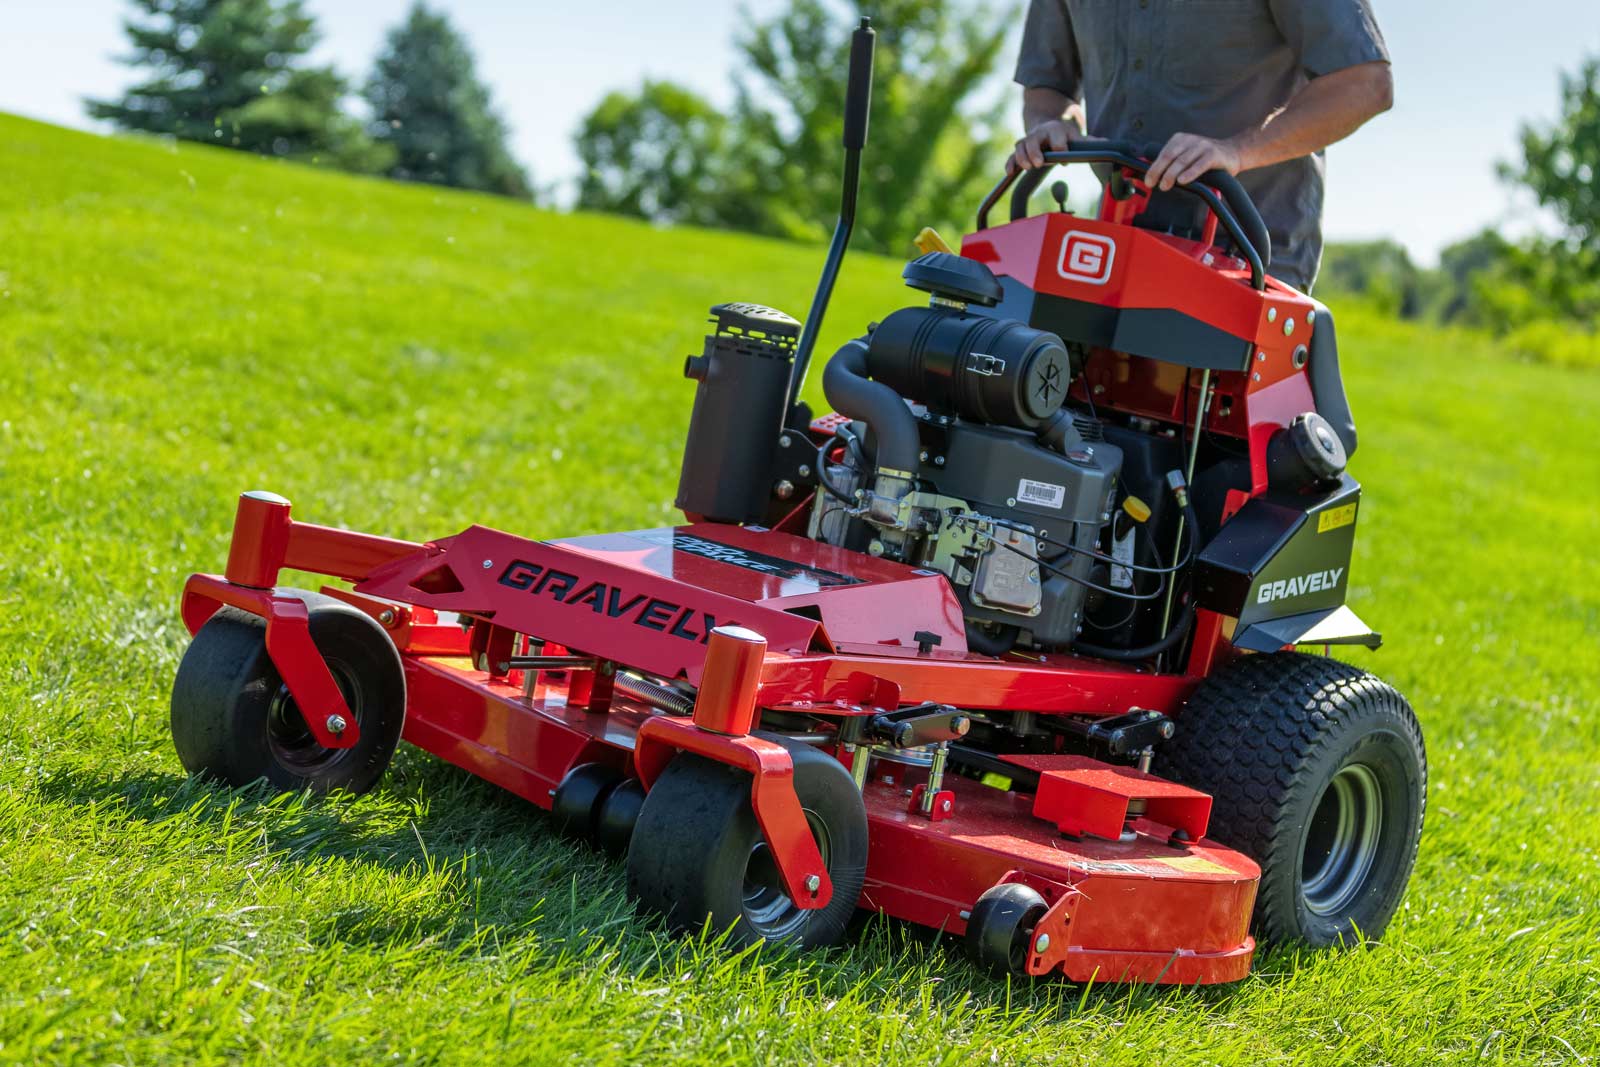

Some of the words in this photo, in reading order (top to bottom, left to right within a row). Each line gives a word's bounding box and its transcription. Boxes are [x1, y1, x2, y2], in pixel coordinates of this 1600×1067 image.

[1069, 241, 1103, 274] G
[664, 543, 780, 571] TANCE
[1257, 567, 1344, 604] GRAVELY
